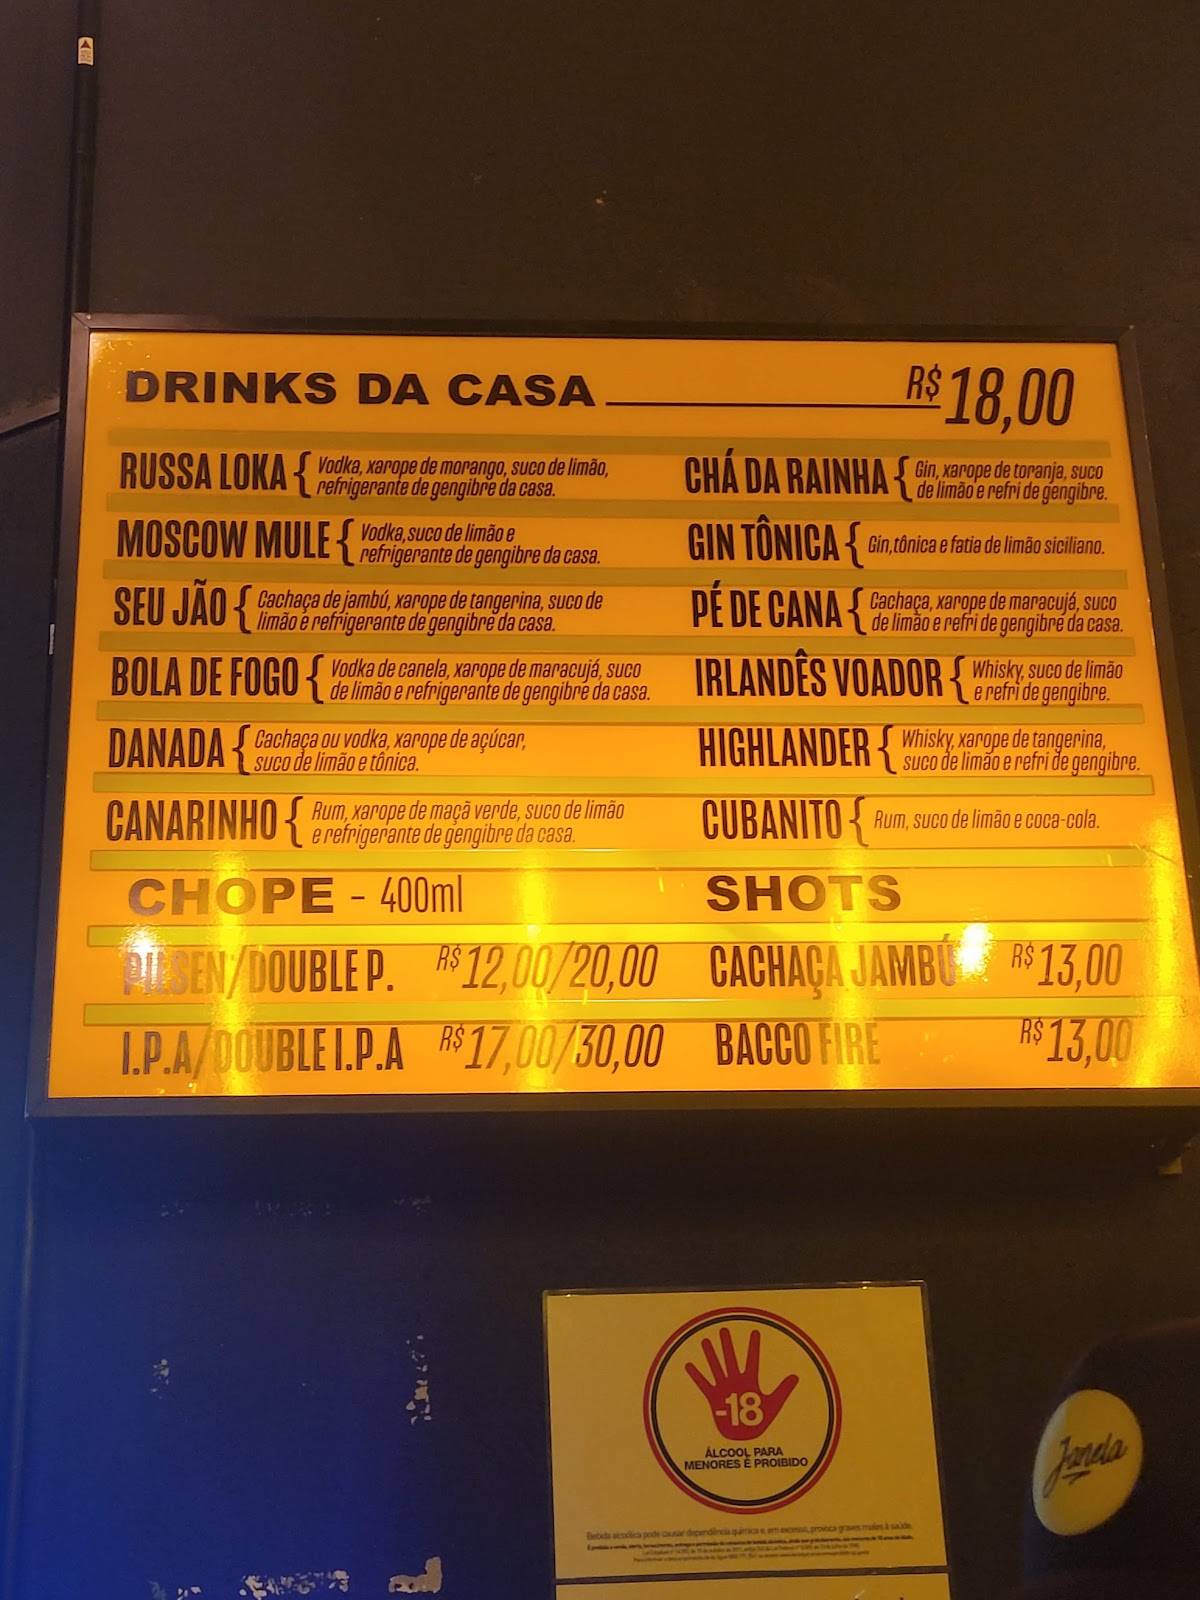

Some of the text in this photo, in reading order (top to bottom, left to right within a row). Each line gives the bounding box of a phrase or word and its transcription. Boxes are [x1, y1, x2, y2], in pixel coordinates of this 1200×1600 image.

[125, 371, 596, 406] DRINKS DA CASA
[906, 364, 1074, 433] R$ 18,00
[120, 452, 287, 490] RUSSA LOKA
[318, 456, 608, 479] Vodka, xarope de morango, suco de limão,
[684, 448, 888, 494] CHÁ DA RAINHA
[916, 460, 1103, 483] Gin, xarope de toranja, suco
[317, 478, 555, 500] refrigerante de gengibre da casa.
[917, 480, 1107, 505] de limão e refri de gengibre.
[117, 520, 330, 559] MOSCOW MULE
[445, 524, 462, 542] de
[465, 524, 504, 542] limão
[506, 528, 515, 542] e
[688, 514, 839, 561] GIN TÔNICA
[940, 538, 947, 553] e
[951, 535, 981, 553] fatia
[985, 536, 1000, 553] de
[1004, 536, 1041, 554] limão
[1044, 536, 1105, 554] siciliano.
[114, 579, 226, 626] SEU JÃO
[257, 589, 603, 614] Cachaça de jambú, xarope de tangerina, suco de
[692, 580, 842, 628] PÉ DE CANA
[871, 591, 1116, 615] Cachaça, xarope de maracujá, suco
[111, 657, 298, 696] BOLA DE FOGO
[330, 659, 641, 683] Vodka de canela, xarope de maracujá, suco
[695, 648, 943, 697] IRLANDÊS VOADOR
[973, 660, 1123, 684] Whisky, suco de limão
[975, 682, 1110, 706] e refri de gengibre.
[108, 728, 224, 768] DANADA
[255, 729, 526, 754] Cachaça ou vodka, xarope de açúcar,
[698, 728, 871, 767] HIGHLANDER
[903, 728, 1106, 753] Whisky, xarope de tangerina,
[903, 752, 1140, 777] suco de limão e refri de gengibre.
[106, 799, 277, 841] CANARINHO
[312, 800, 624, 825] Rum, xarope de maçã verde, suco de limão
[702, 800, 842, 840] CUBANITO
[874, 809, 1100, 831] Rum, suco de limão e coca-cola.
[128, 877, 334, 916] CHOPE
[381, 875, 463, 912] 400ml
[706, 875, 901, 911] SHOTS
[367, 950, 393, 992] P.
[436, 944, 462, 972] R$
[710, 933, 956, 999] CACHAÇA JAMBÚ
[1011, 943, 1123, 993] R$ 13,00
[335, 1027, 404, 1070] I.P.A
[440, 1024, 464, 1052] R$
[715, 1022, 880, 1065] BACCO FIRE
[1019, 1017, 1133, 1068] R$ 13,00
[685, 1458, 808, 1470] MENORES É PROIBIDO
[705, 1447, 783, 1458] ÁLCOOL PARA
